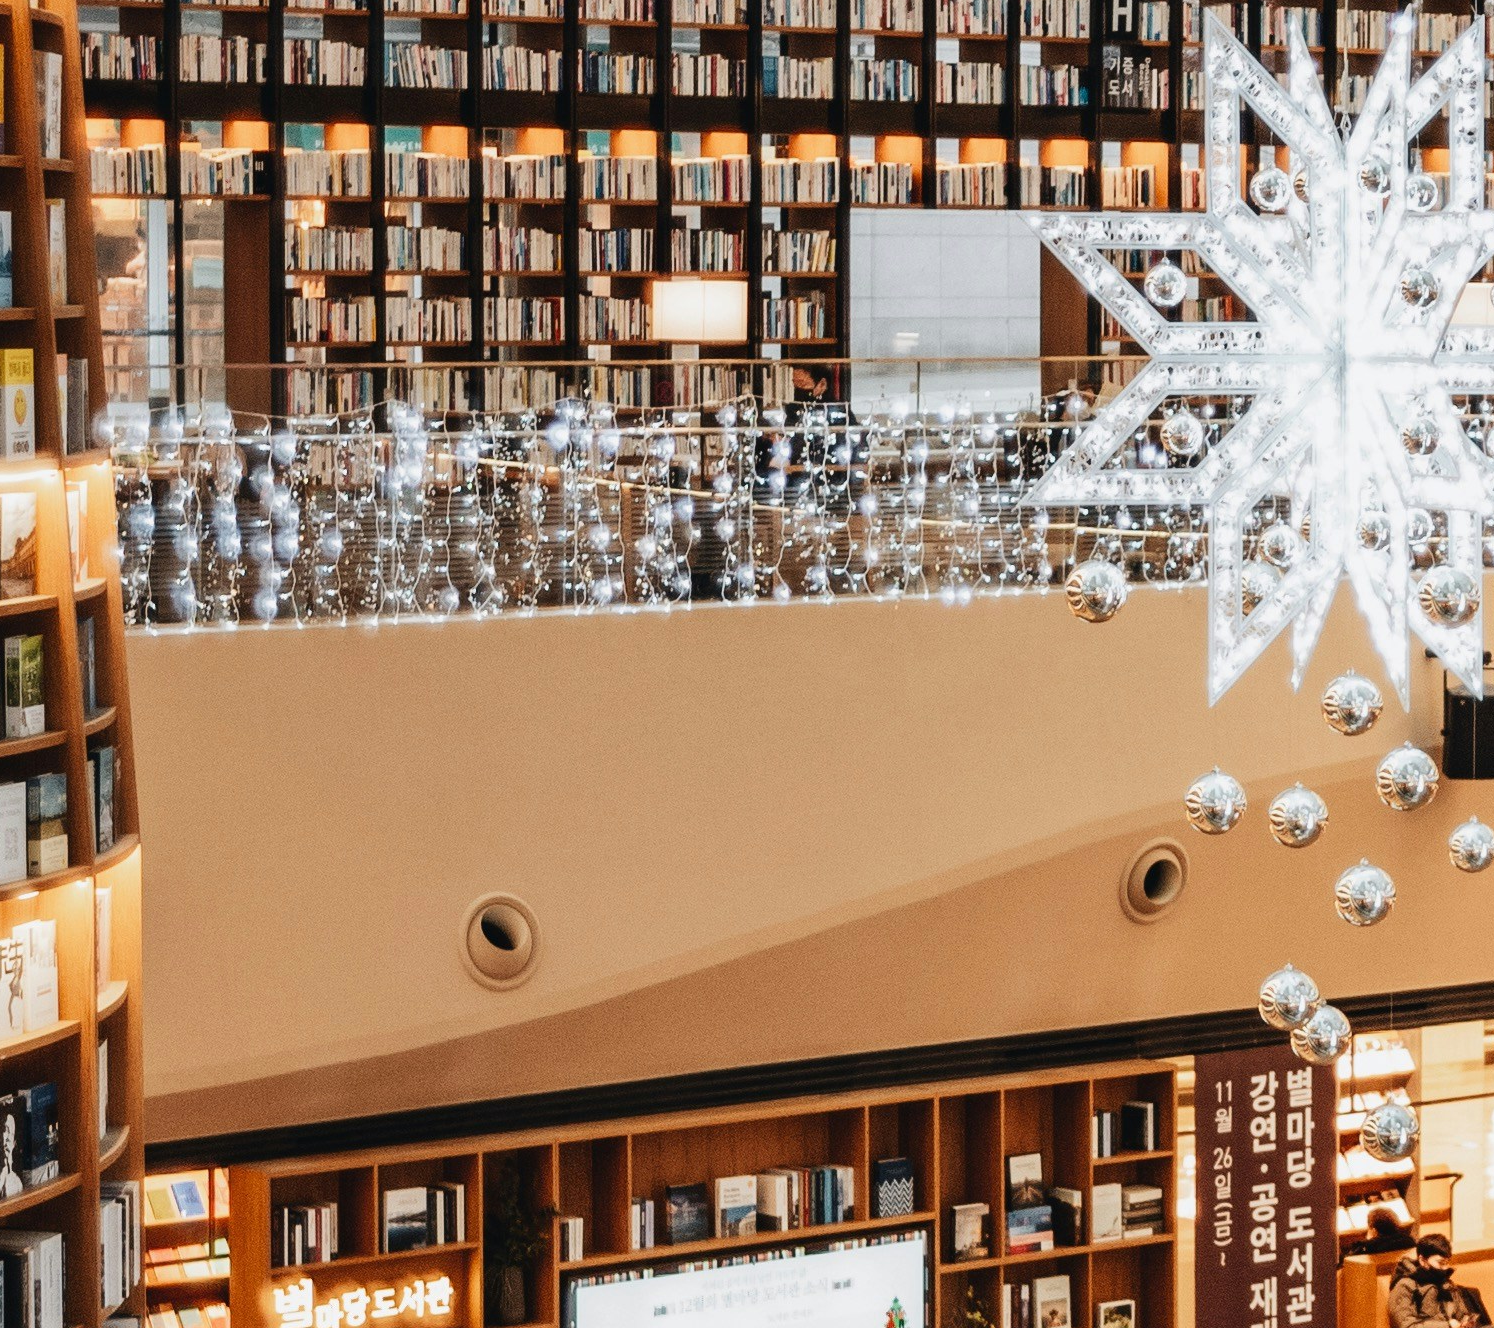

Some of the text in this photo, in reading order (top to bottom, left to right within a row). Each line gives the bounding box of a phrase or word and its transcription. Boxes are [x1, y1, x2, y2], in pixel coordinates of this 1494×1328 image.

[1109, 57, 1134, 75] 기증
[1108, 79, 1134, 97] 도서
[1214, 1079, 1233, 1134] 11월
[1284, 1066, 1315, 1325] 별마당 도서관
[370, 1276, 453, 1318] 도서관
